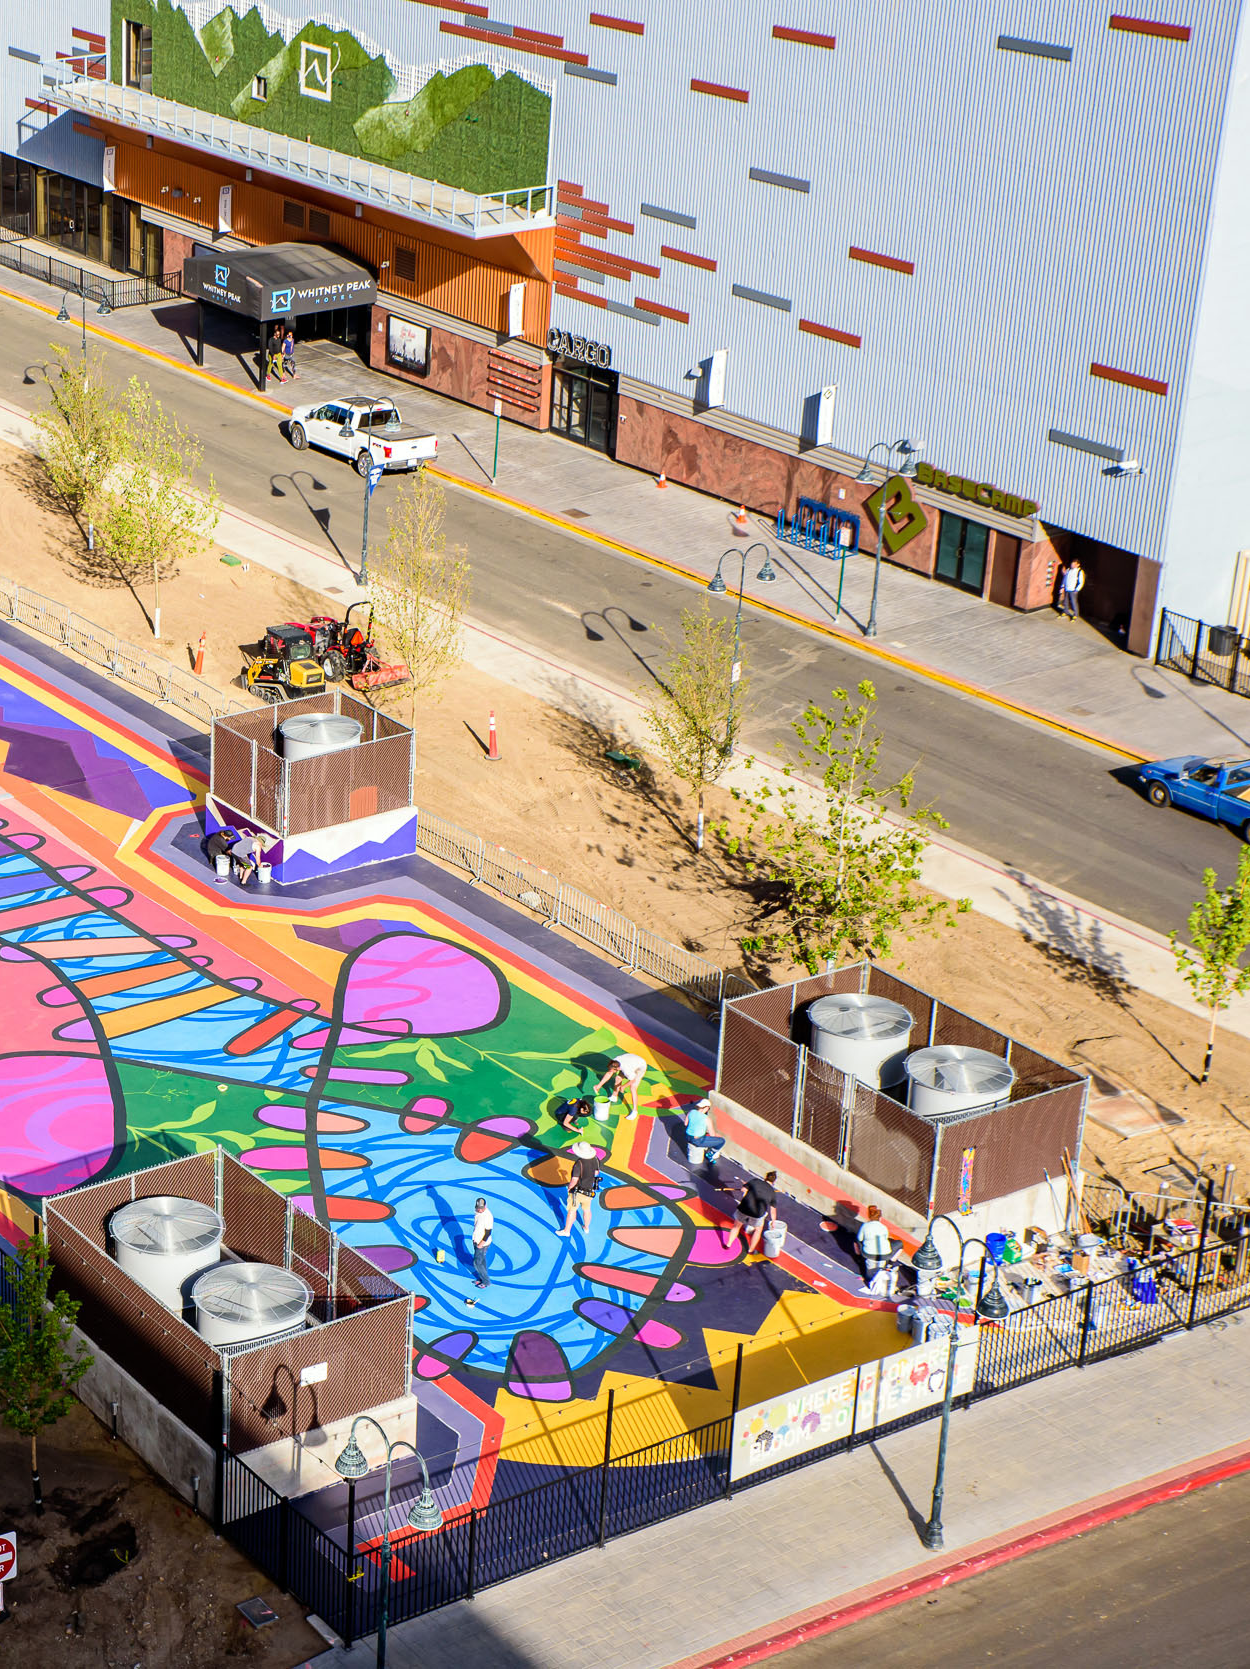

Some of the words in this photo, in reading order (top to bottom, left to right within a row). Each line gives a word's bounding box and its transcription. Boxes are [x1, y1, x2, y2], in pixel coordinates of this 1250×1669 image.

[202, 281, 227, 298] WHITNEY
[227, 291, 241, 304] PEAK
[297, 282, 344, 299] WHITNEY
[346, 279, 372, 292] PEAK
[315, 294, 354, 304] HOTEL
[546, 327, 612, 369] CARGO
[915, 1363, 969, 1401] HOE
[787, 1380, 854, 1419] WHERE
